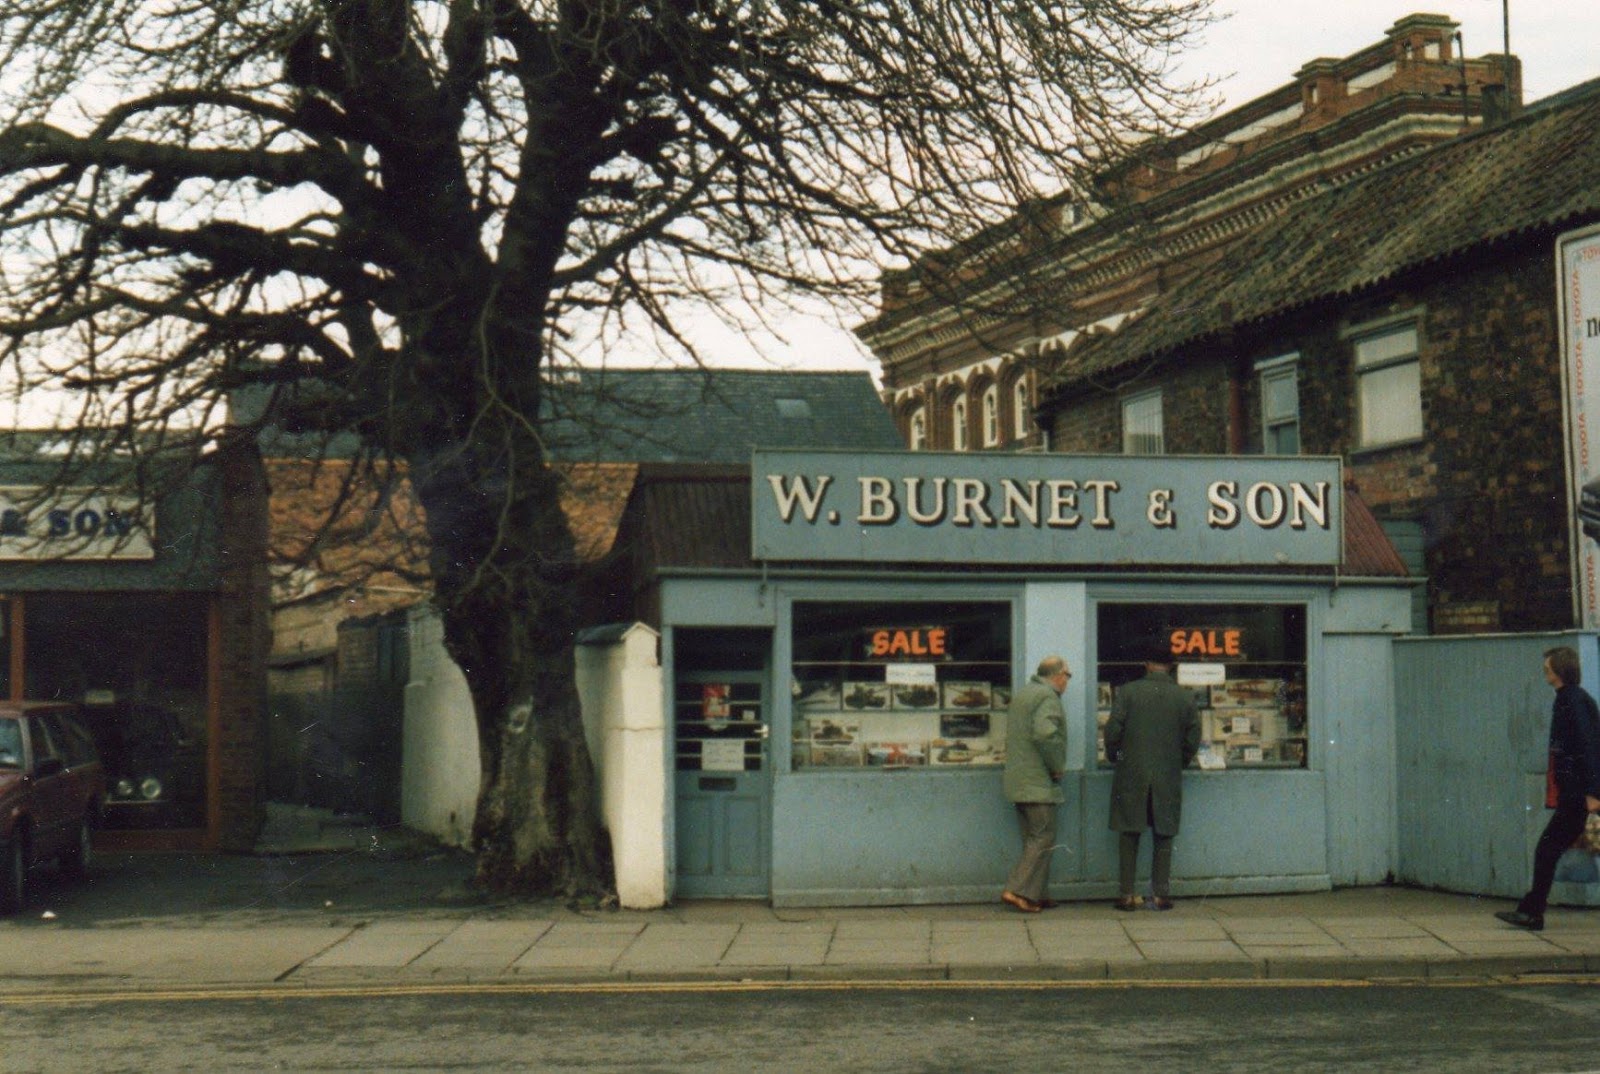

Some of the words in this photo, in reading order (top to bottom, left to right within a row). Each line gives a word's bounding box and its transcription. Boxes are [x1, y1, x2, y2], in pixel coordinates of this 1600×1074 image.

[1572, 269, 1582, 326] TOYOTA
[1586, 317, 1600, 338] n
[1575, 342, 1584, 396] TOYOTA
[1578, 411, 1588, 467] TOYOTA
[48, 508, 133, 537] SON
[767, 474, 840, 524] W.
[857, 476, 1120, 528] BURNET
[1147, 488, 1176, 529] &
[1207, 480, 1330, 530] SON
[1587, 555, 1596, 612] TOYOTA
[871, 628, 946, 656] SALE
[1169, 629, 1242, 655] SALE
